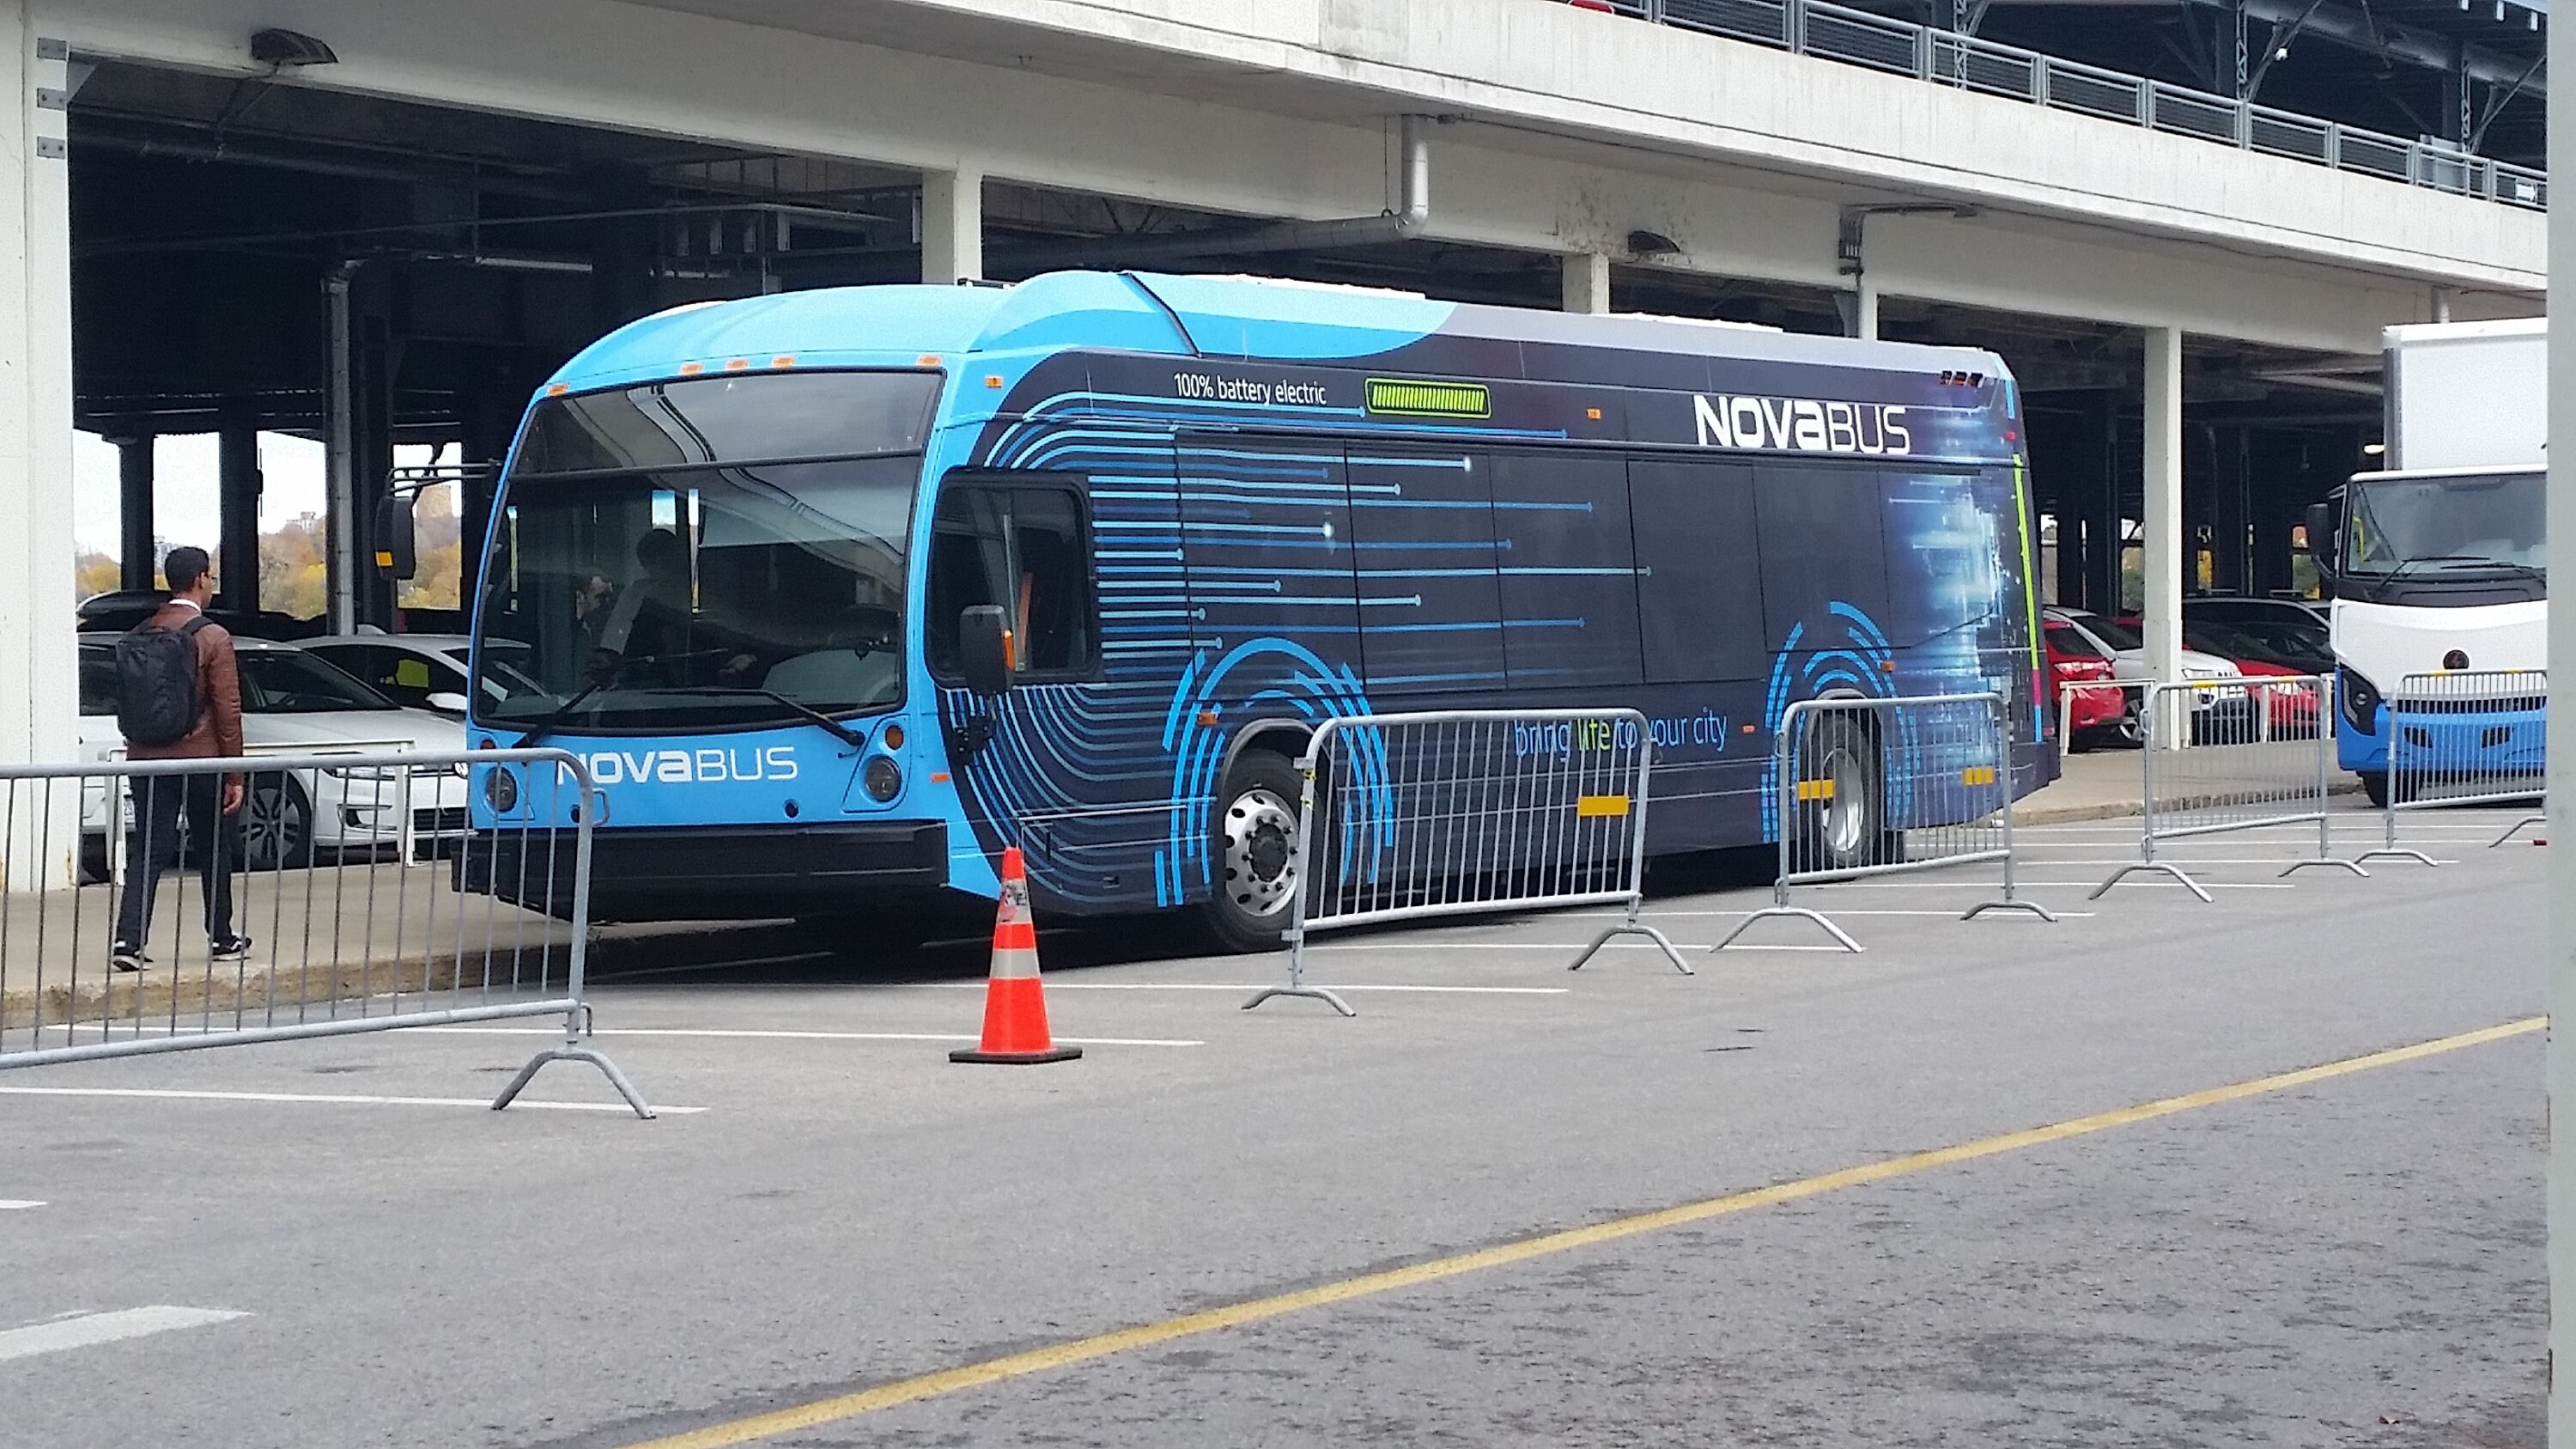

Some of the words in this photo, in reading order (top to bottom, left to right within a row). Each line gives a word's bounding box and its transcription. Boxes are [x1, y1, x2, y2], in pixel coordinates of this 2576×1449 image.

[1174, 372, 1215, 399] 100%
[1217, 375, 1271, 406] battery
[1274, 379, 1327, 405] electric
[1514, 719, 1570, 763] bring
[1577, 717, 1611, 750] life
[1616, 717, 1638, 749] to
[1693, 706, 1728, 752] city
